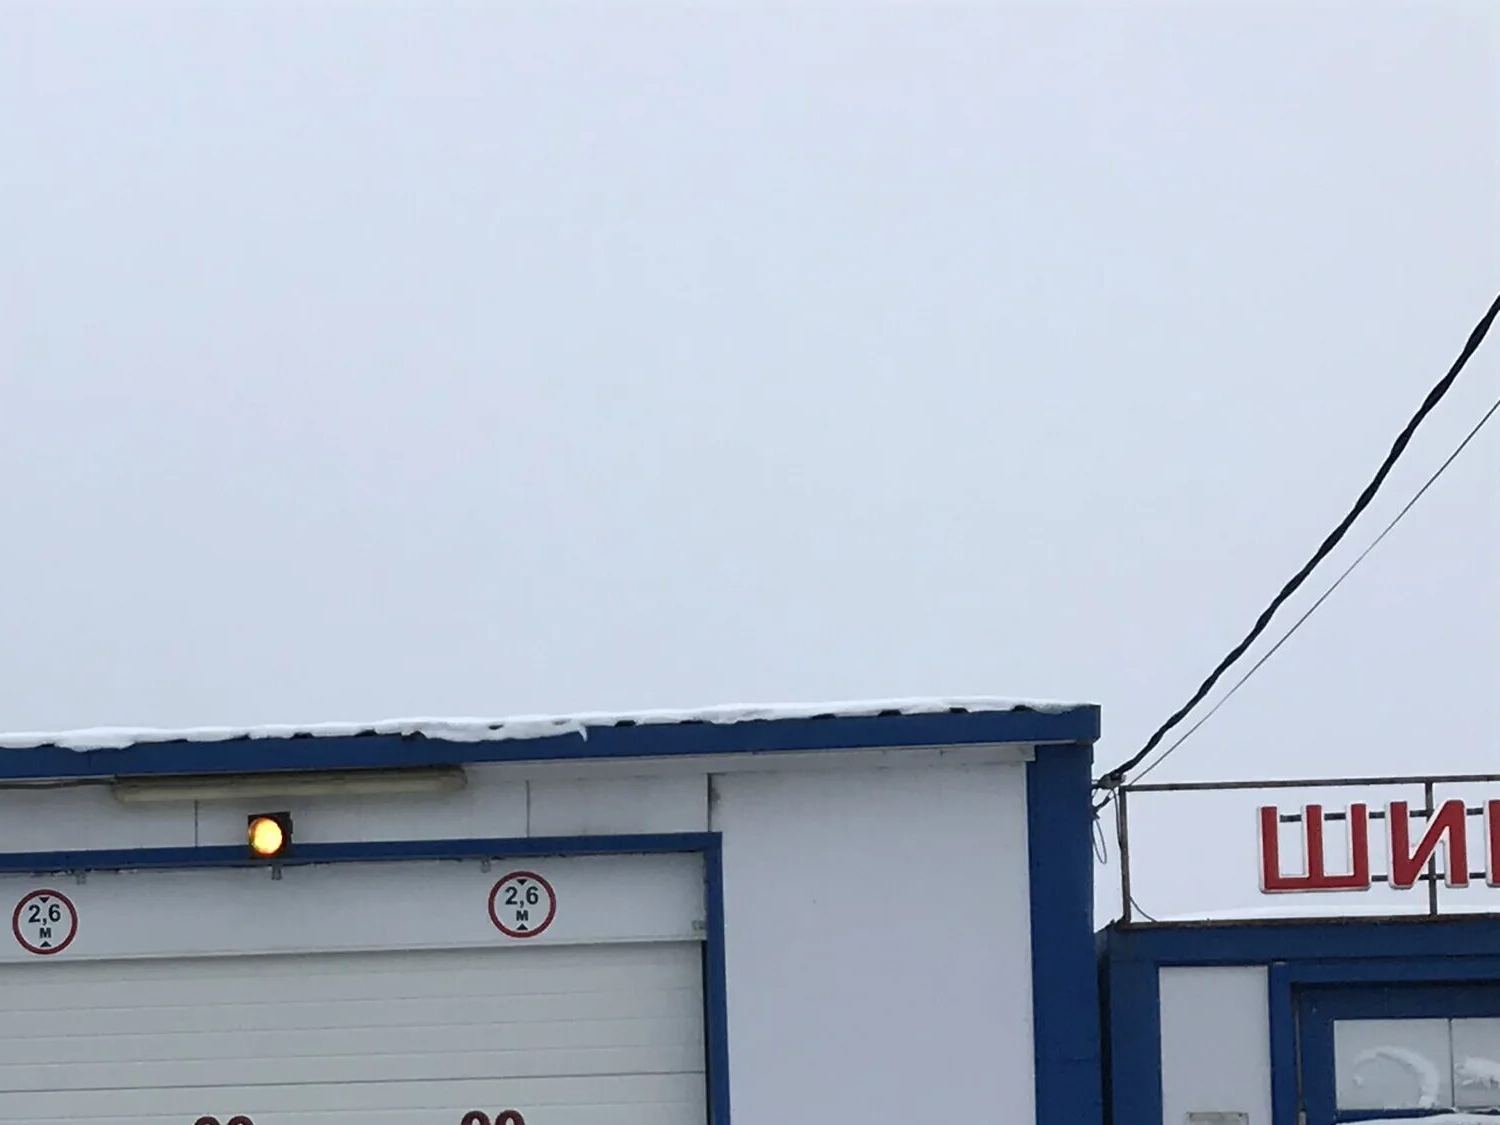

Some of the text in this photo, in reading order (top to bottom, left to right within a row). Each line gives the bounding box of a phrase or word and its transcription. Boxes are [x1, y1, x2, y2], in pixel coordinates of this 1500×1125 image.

[1258, 799, 1500, 894] ШИ
[504, 885, 539, 908] 2,6
[28, 903, 61, 926] 2,6
